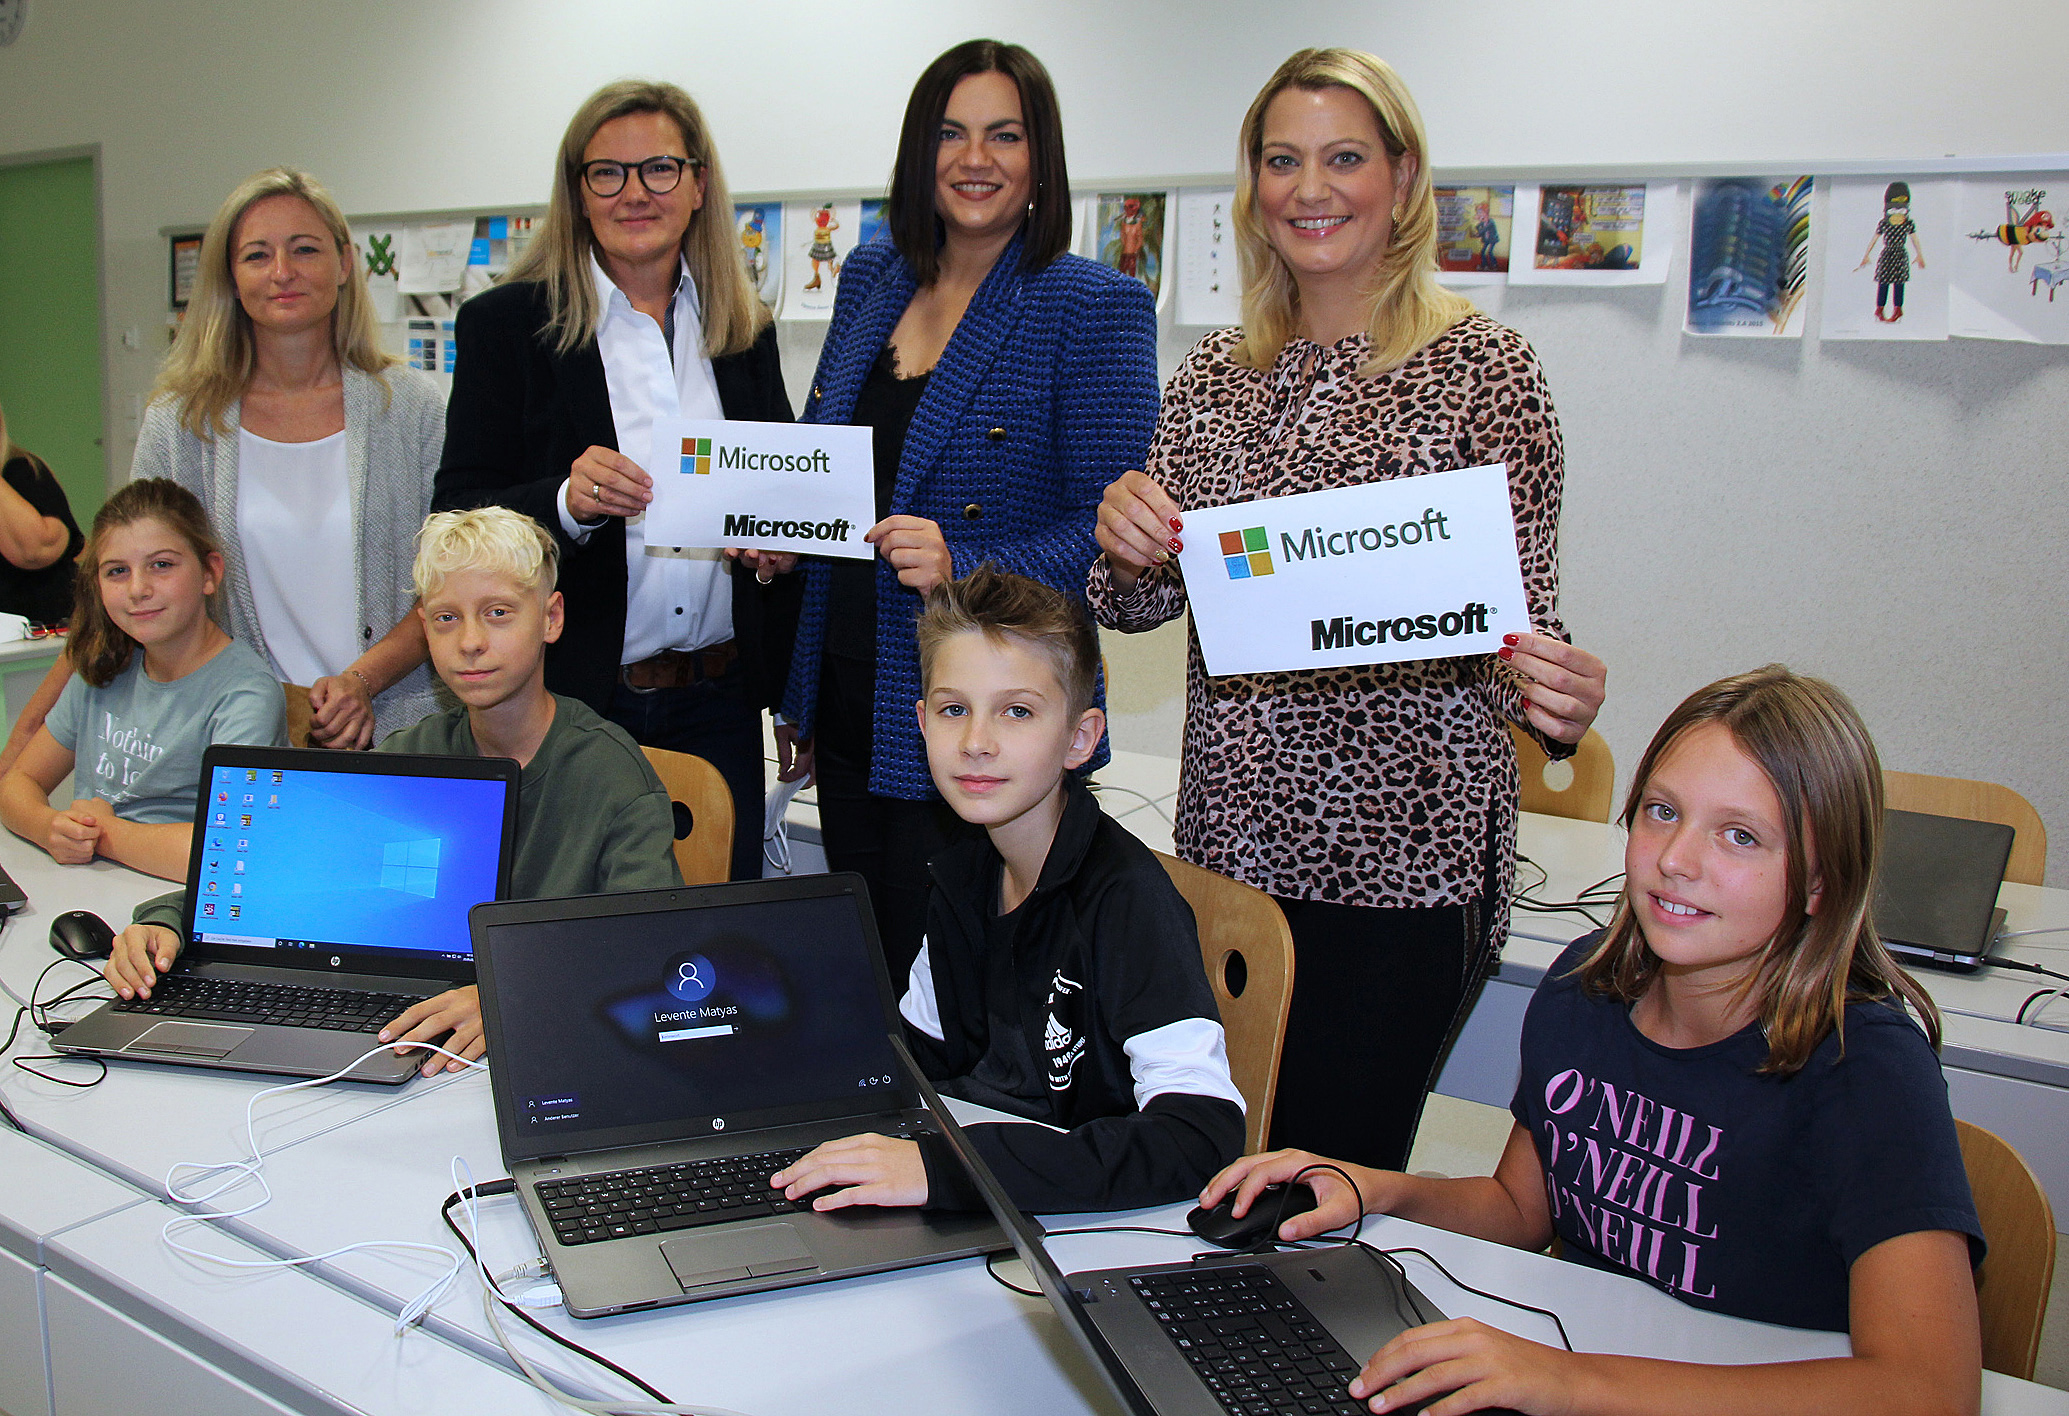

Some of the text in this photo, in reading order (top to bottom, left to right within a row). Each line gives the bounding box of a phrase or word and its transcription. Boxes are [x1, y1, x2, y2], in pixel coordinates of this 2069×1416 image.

[718, 446, 831, 474] Microsoft
[1280, 507, 1451, 563] Microsoft
[98, 711, 163, 762] Nothin
[96, 752, 115, 779] to
[654, 1005, 738, 1023] Levente Matyas
[712, 1117, 725, 1131] hp
[1545, 1067, 1724, 1181] O'NEILL
